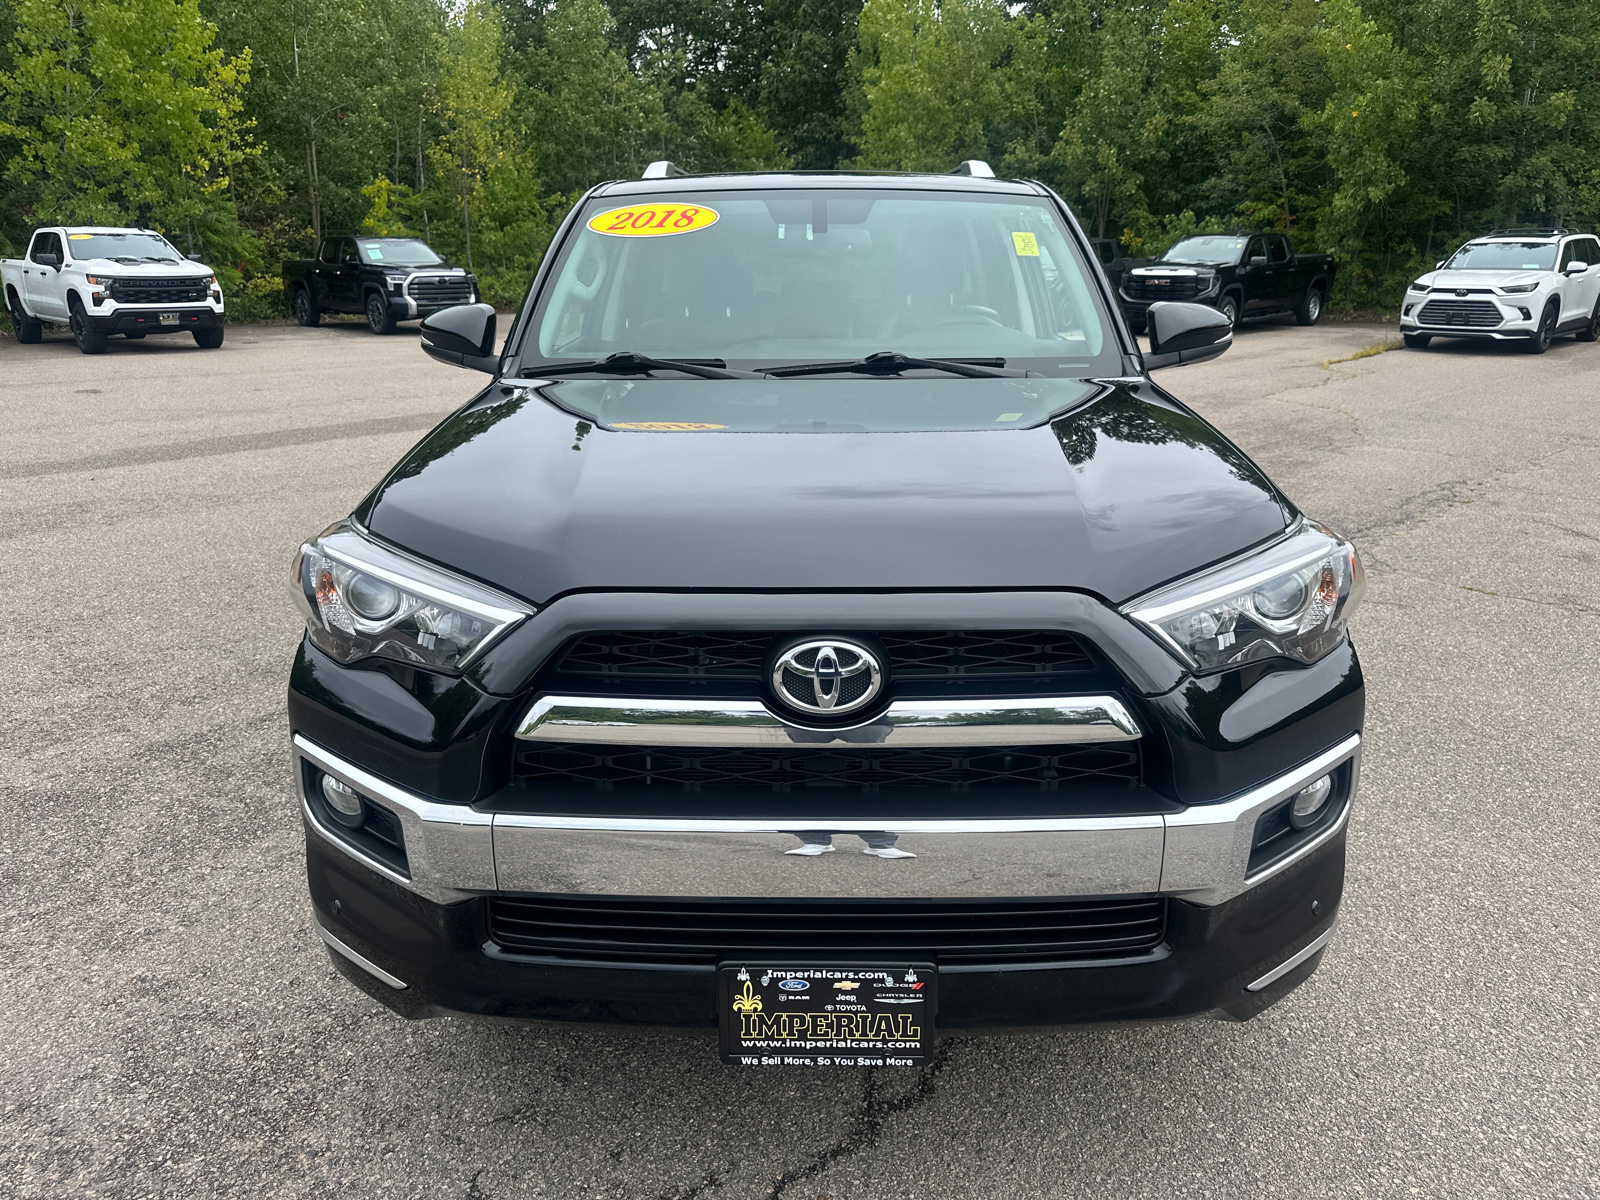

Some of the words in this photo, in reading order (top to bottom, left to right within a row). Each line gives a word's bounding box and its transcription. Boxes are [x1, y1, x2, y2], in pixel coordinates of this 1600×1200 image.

[606, 208, 700, 231] 2018
[767, 970, 888, 980] Imperialcars.com
[785, 981, 803, 989] Ford
[835, 994, 857, 1002] Jeep
[740, 1013, 921, 1039] IMPERIAL
[741, 1039, 921, 1049] www.imperialcars.com
[741, 1056, 759, 1065] We
[761, 1056, 780, 1065] Sell
[784, 1056, 814, 1067] More,
[817, 1057, 831, 1065] So
[834, 1057, 854, 1066] You
[857, 1057, 883, 1066] Save
[886, 1057, 913, 1066] More
